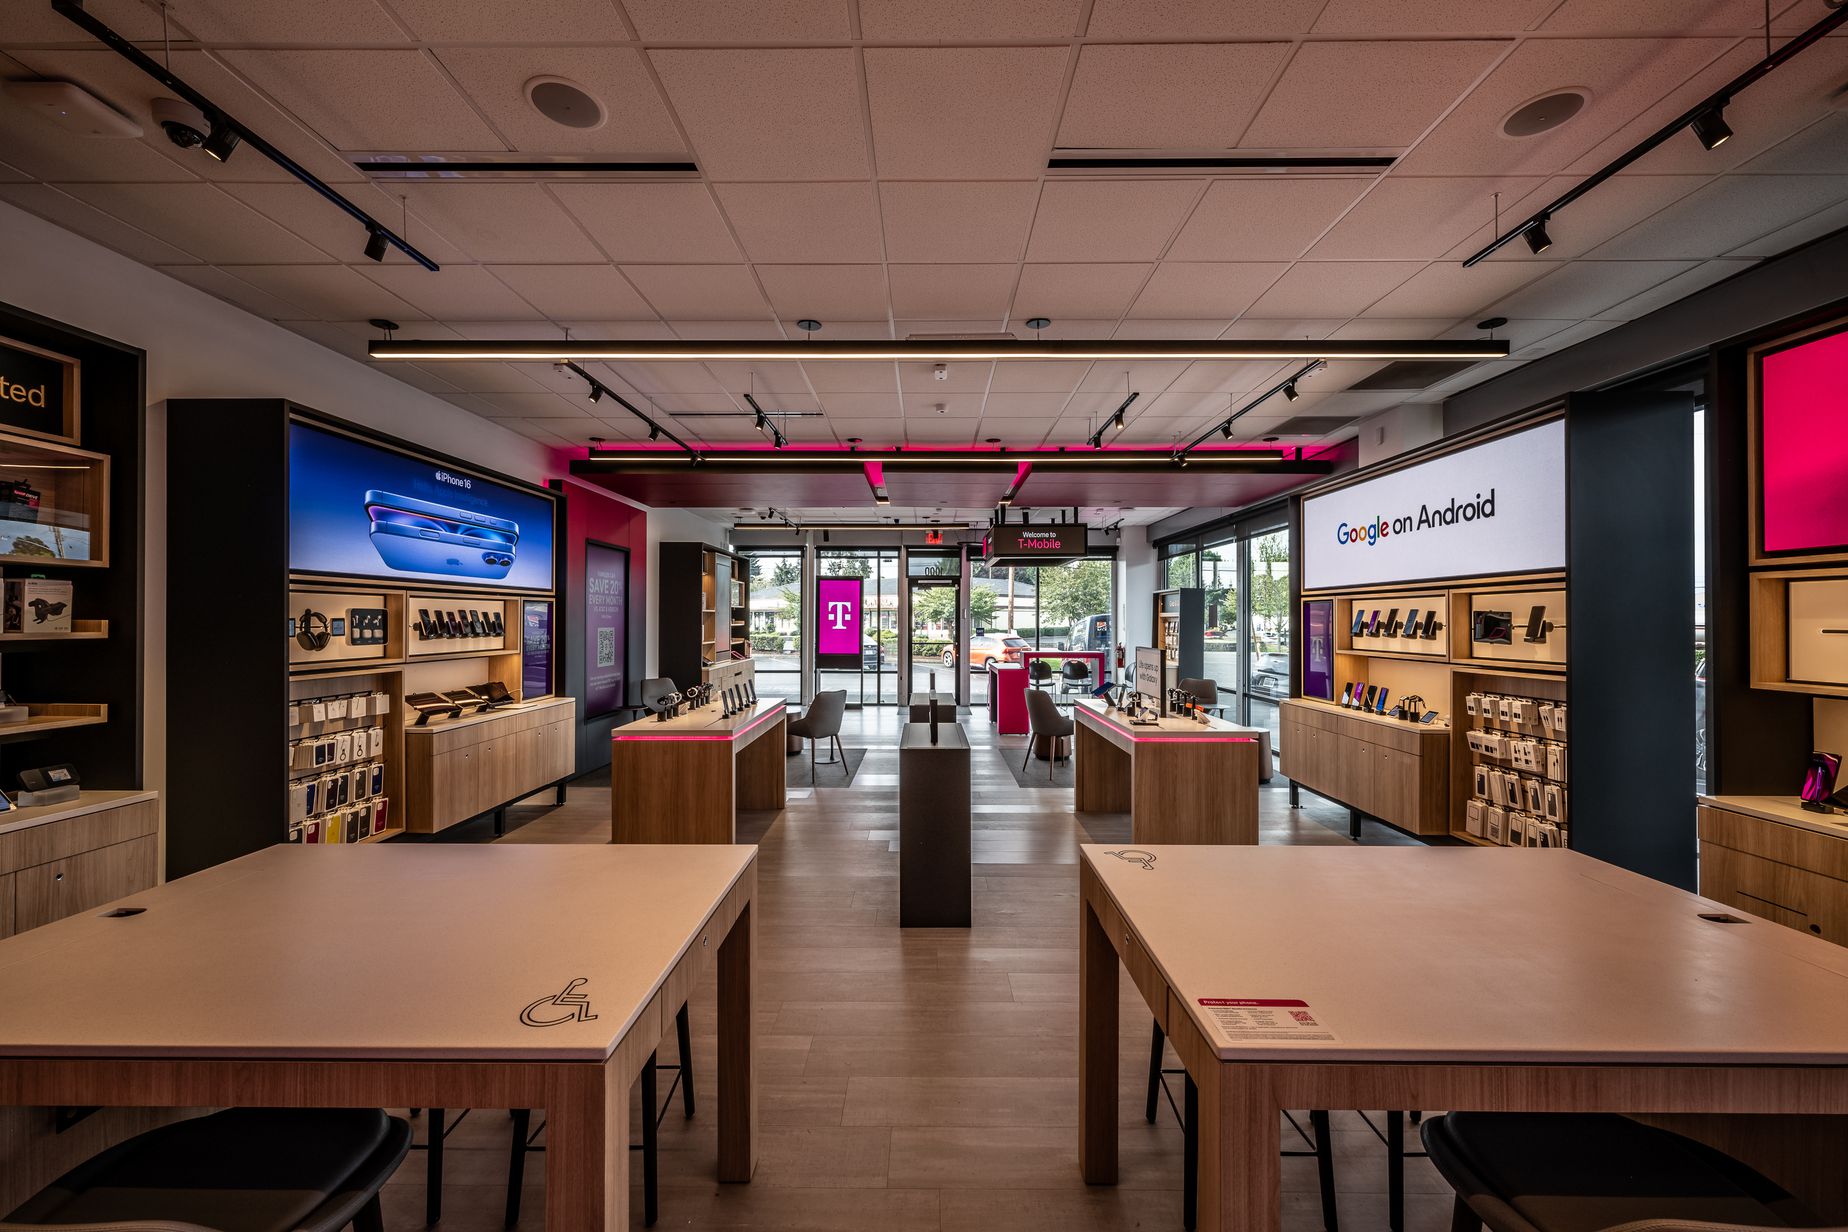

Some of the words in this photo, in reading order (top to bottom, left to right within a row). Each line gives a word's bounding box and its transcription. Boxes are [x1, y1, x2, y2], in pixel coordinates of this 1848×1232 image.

[0, 375, 45, 408] ted
[441, 472, 464, 487] iPhone
[464, 479, 472, 489] 16
[1337, 515, 1389, 546] Google
[1392, 516, 1413, 535] on
[1416, 488, 1495, 531] Android
[1017, 538, 1061, 549] T-Mobile
[589, 577, 609, 594] SAVE
[589, 594, 605, 605] EVERY
[606, 595, 623, 606] MONTH
